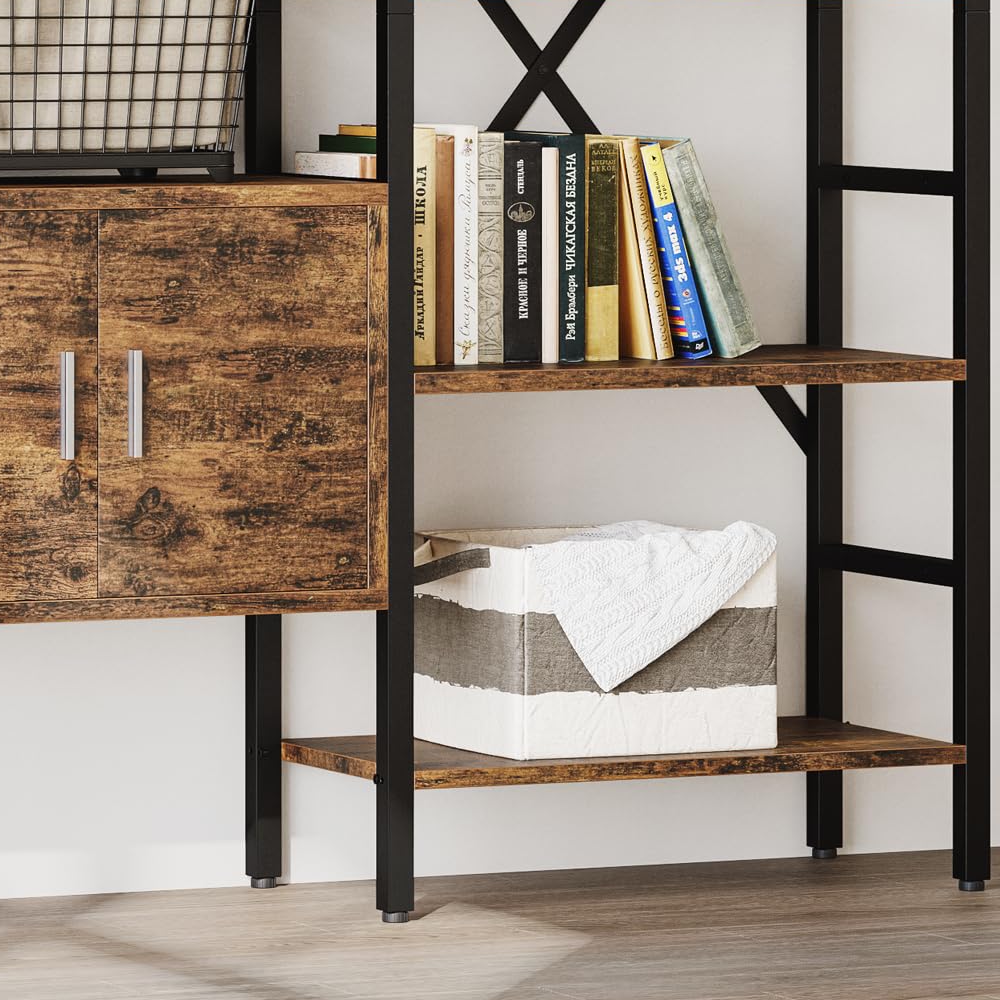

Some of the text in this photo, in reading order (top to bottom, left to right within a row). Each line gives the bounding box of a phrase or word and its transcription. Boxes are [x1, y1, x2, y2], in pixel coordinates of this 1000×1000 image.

[415, 165, 427, 225] ШКОЛА
[565, 152, 577, 199] БЕЗДНА
[517, 229, 528, 264] ЧЕРНОЕ
[565, 201, 577, 271] ЧИКАГСКАЯ
[662, 211, 688, 282] 3ds max 4
[458, 286, 476, 337] Сказки
[518, 277, 529, 320] КРАСНОЕ
[565, 274, 577, 320] Брэдбери
